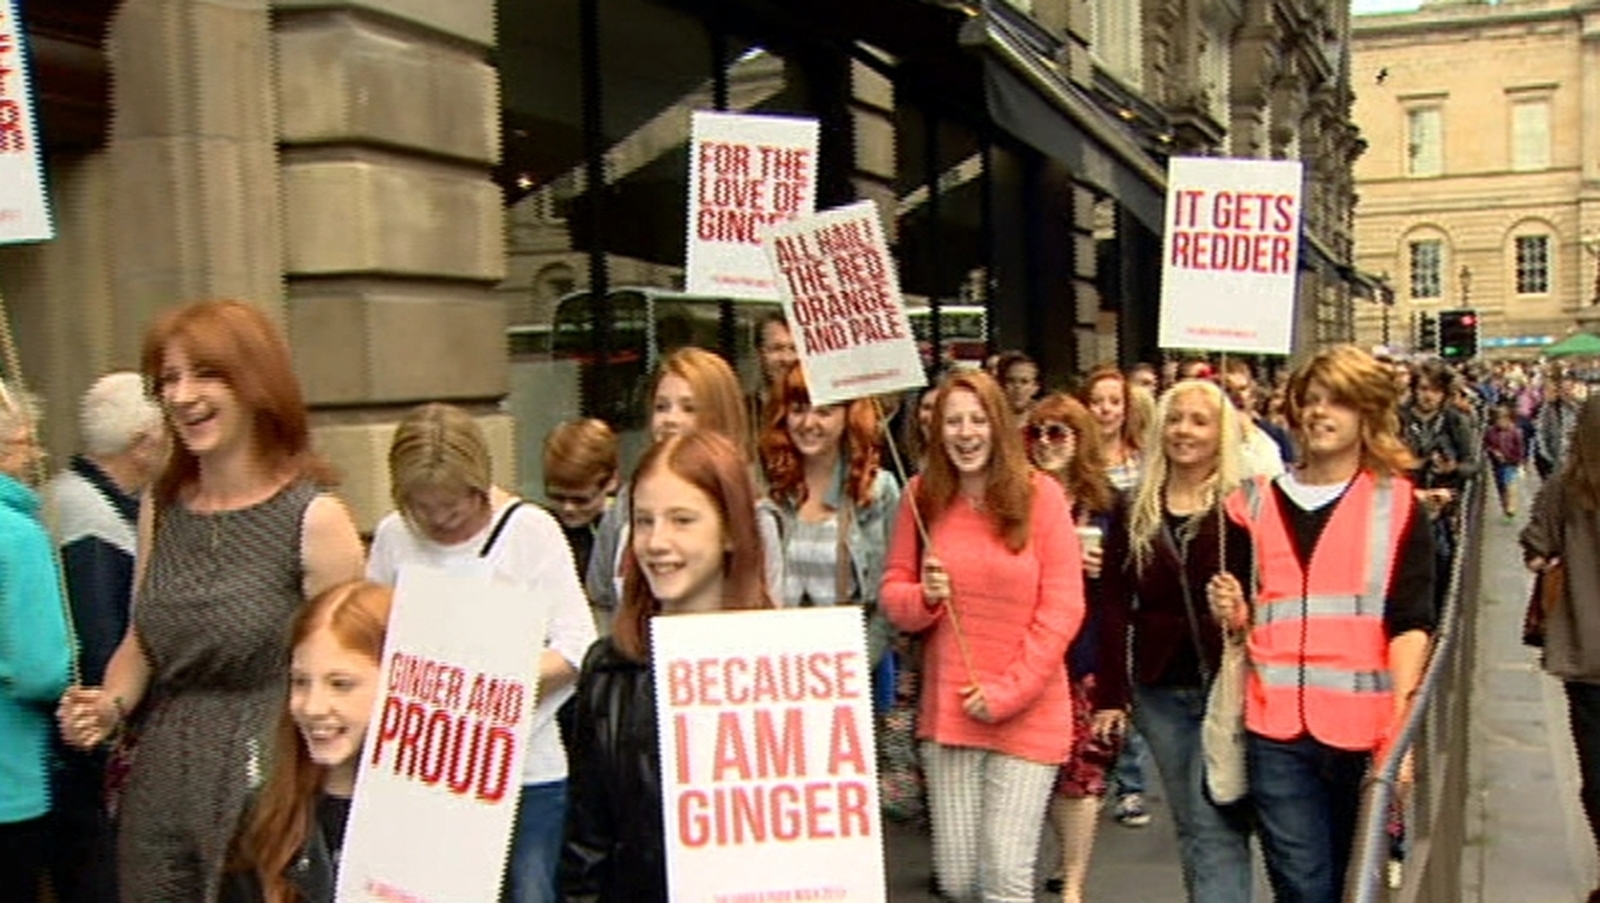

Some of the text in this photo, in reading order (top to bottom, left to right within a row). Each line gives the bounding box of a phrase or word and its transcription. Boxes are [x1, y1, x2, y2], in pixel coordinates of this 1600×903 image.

[699, 142, 809, 180] FOR THE
[698, 175, 807, 213] LOVE OF
[1175, 190, 1294, 232] IT GETS
[775, 233, 817, 265] ALL
[1171, 232, 1291, 274] REDDER
[781, 261, 834, 297] THE
[793, 280, 899, 326] ORANGE
[804, 312, 906, 355] AND PALE
[387, 651, 524, 726] GINGER AND
[668, 651, 861, 706] BECAUSE
[371, 696, 515, 804] PROUD
[674, 705, 867, 784] I AM A
[677, 781, 871, 848] GINGER
